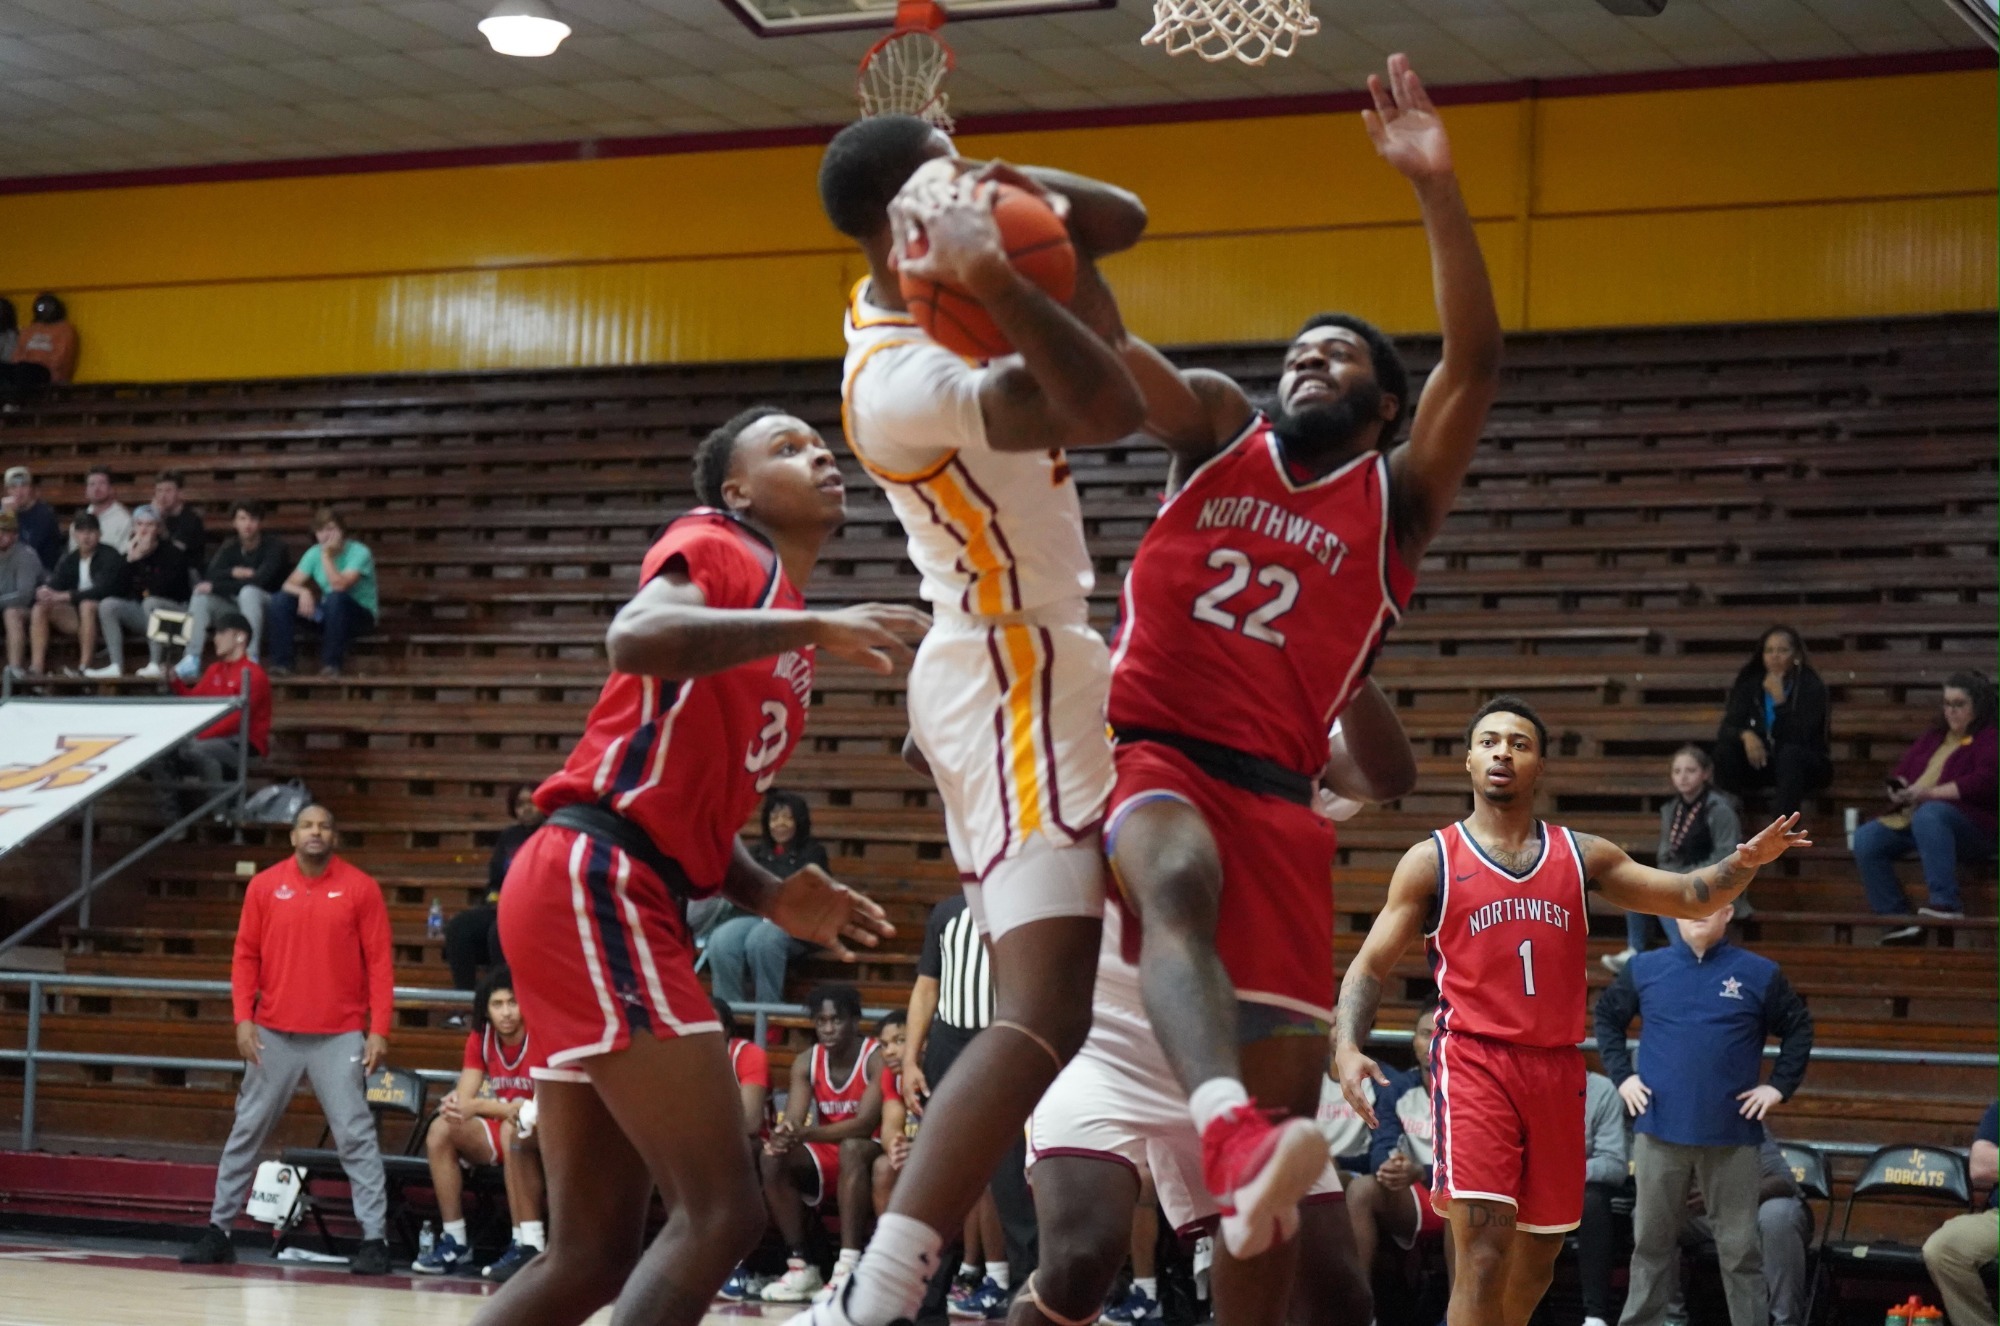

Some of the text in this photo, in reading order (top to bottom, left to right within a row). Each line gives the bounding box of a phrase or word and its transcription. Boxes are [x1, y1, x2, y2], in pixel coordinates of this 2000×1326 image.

[1196, 496, 1348, 576] NORTHWEST
[1192, 547, 1300, 648] 22
[1468, 897, 1571, 937] NORTHWEST
[1517, 939, 1536, 996] 1
[1885, 1167, 1946, 1187] BOBCATS
[1909, 1149, 1926, 1169] JC
